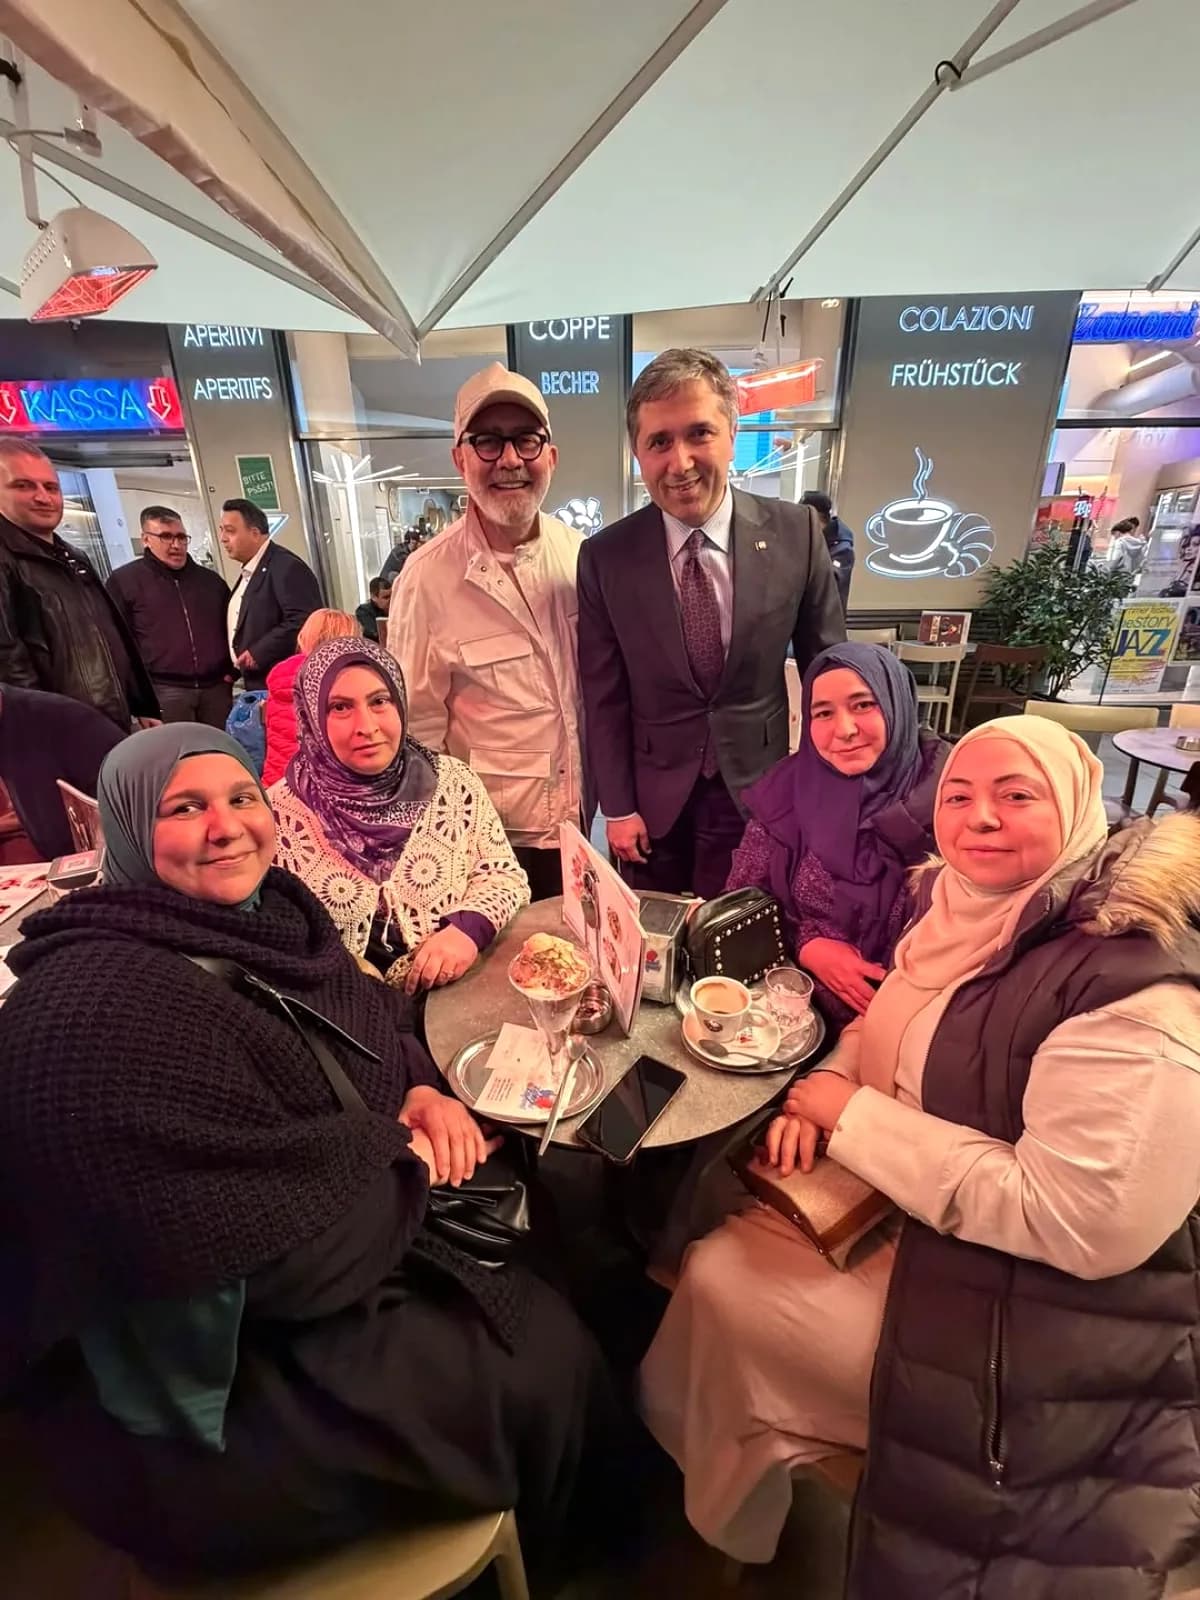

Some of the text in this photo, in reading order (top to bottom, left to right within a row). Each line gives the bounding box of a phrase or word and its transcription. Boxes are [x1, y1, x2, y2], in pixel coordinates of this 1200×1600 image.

[528, 316, 610, 340] COPPE
[899, 305, 1035, 332] COLAZIONI
[541, 371, 600, 395] BECHER
[890, 358, 1022, 387] FRÜHSTÜCK
[194, 377, 273, 400] APERITIFS
[20, 388, 145, 422] KASSA
[242, 471, 267, 485] BITTE
[1113, 629, 1171, 656] JAZZ
